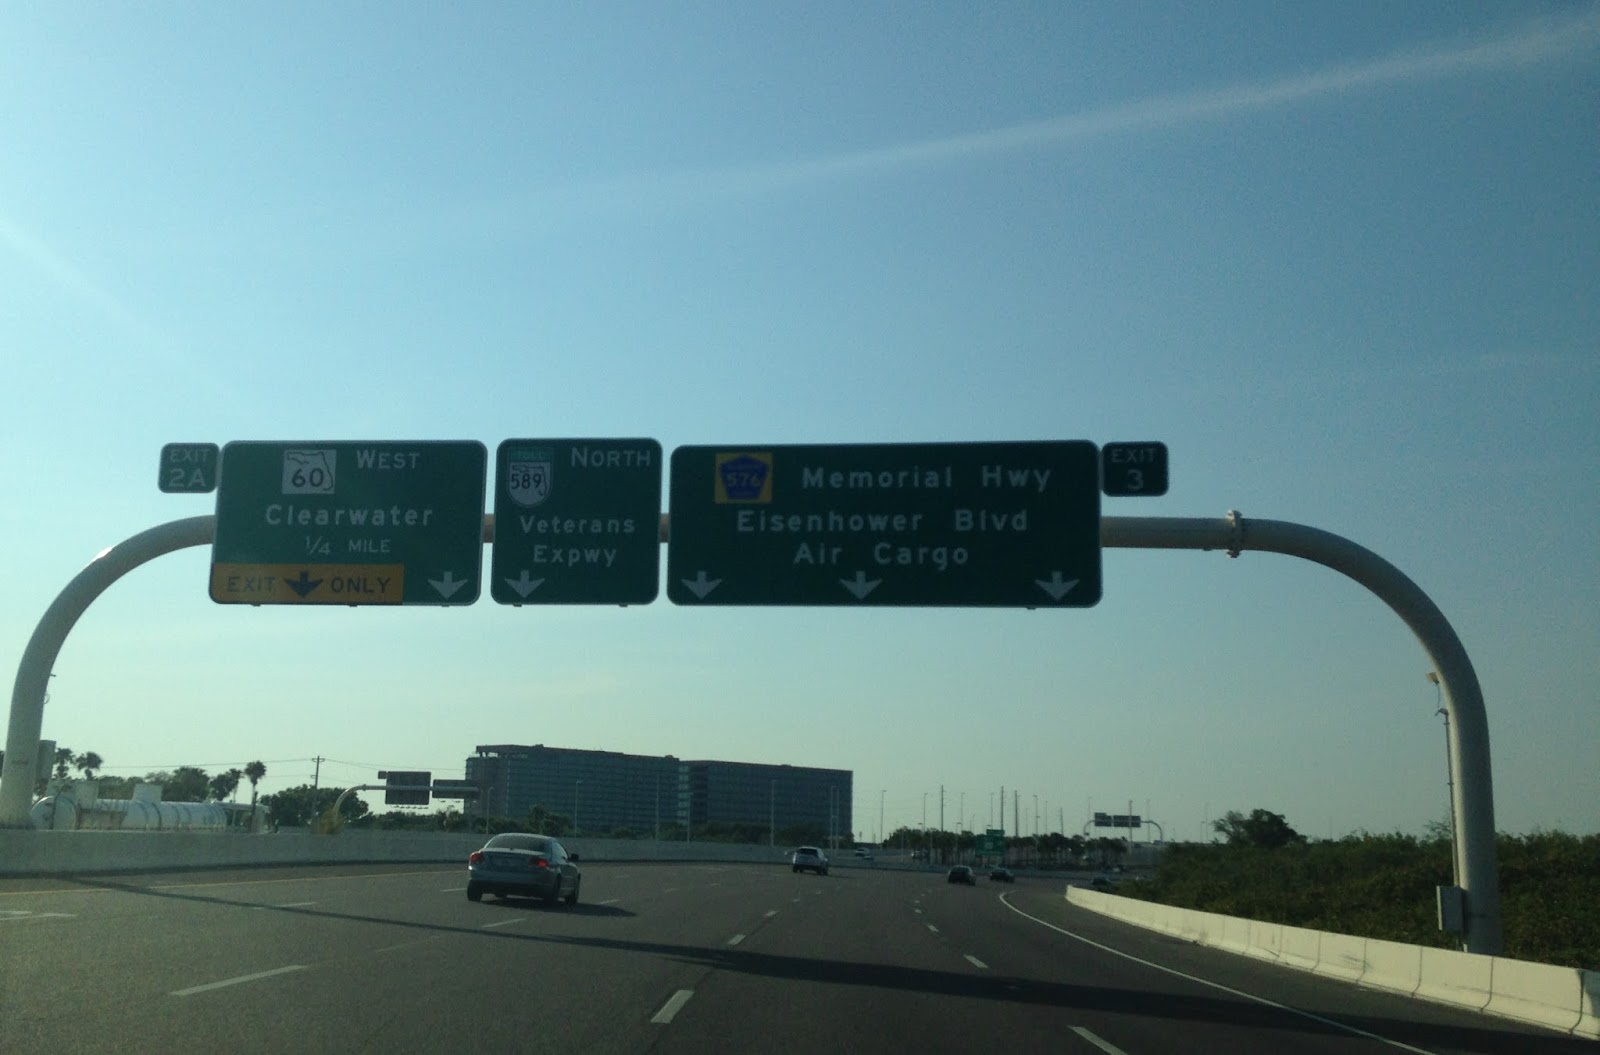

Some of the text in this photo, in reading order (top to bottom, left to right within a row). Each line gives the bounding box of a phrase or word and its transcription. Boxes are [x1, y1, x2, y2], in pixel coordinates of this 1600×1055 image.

[168, 448, 209, 463] EXIT
[355, 449, 421, 470] WEST
[570, 448, 650, 468] NORTH
[1110, 447, 1157, 463] EXIT
[167, 468, 208, 488] 2A
[290, 467, 325, 488] 60
[510, 473, 542, 490] 589
[727, 472, 761, 488] 576
[802, 464, 1051, 492] Memorial Hwy
[1126, 470, 1144, 490] 3
[264, 503, 433, 527] Clearwater
[519, 515, 636, 534] Veterans
[736, 508, 1028, 533] Eisenhower Blvd
[347, 539, 391, 554] MILE
[533, 544, 617, 567] Expwy
[793, 542, 969, 571] Air Cargo
[226, 575, 391, 594] EXIT ONLY
